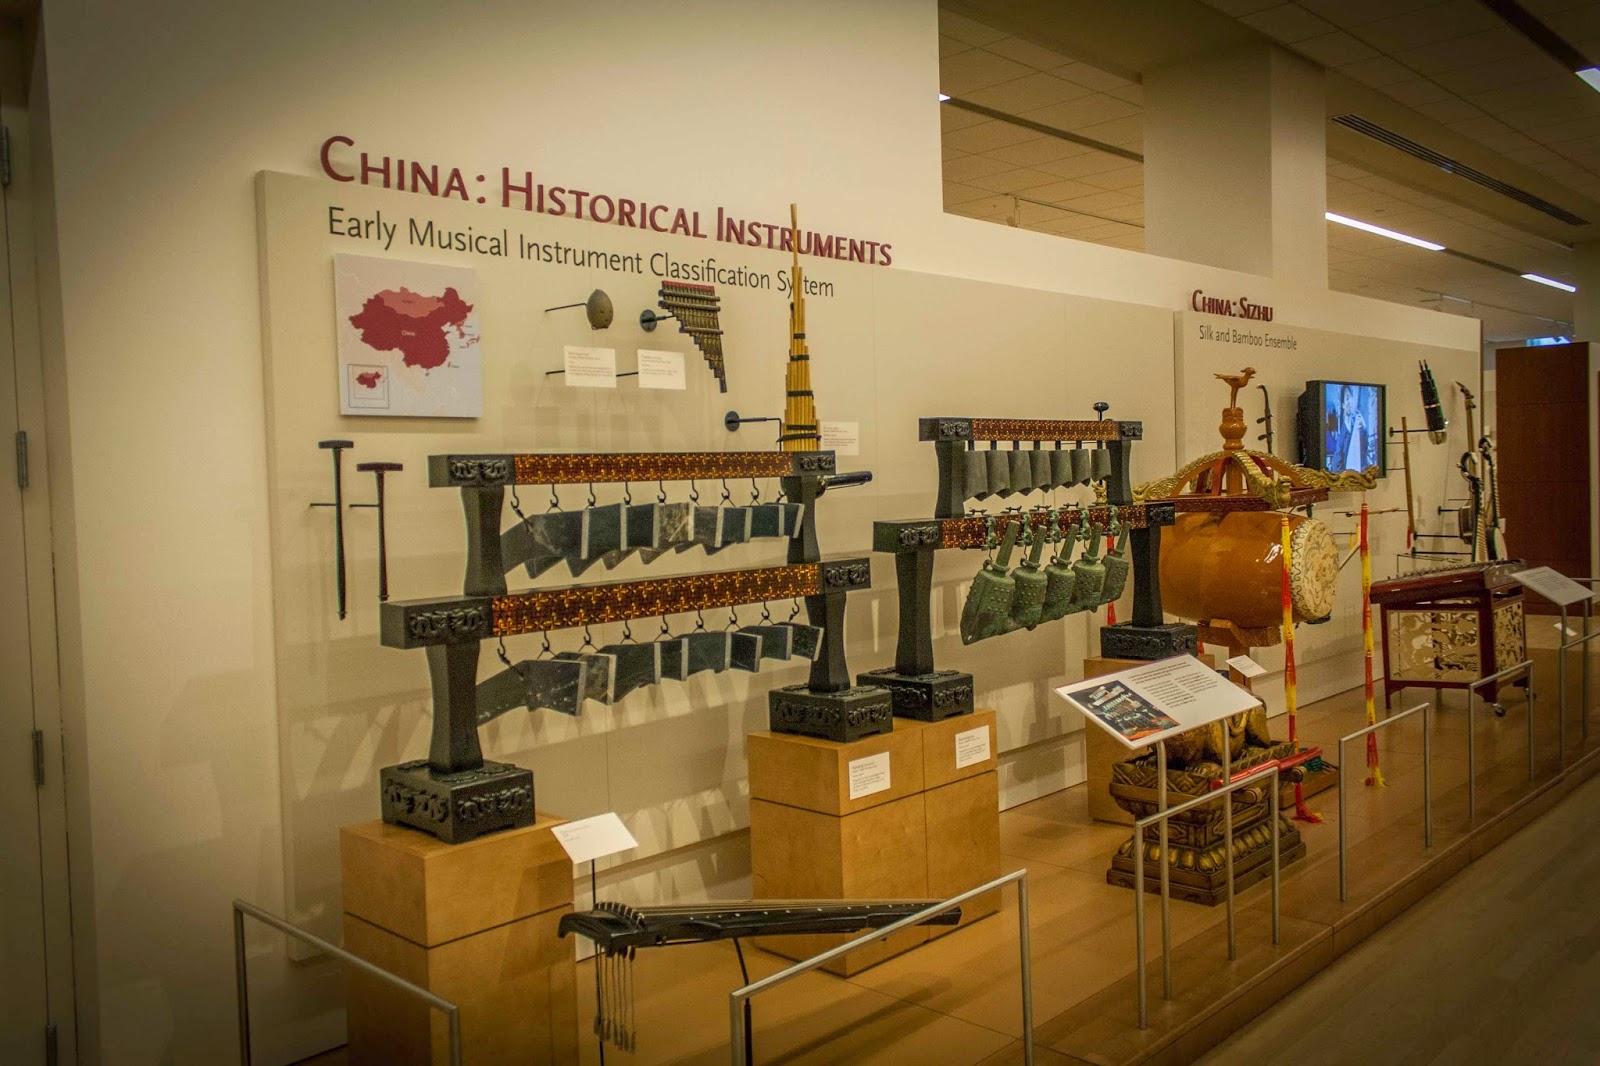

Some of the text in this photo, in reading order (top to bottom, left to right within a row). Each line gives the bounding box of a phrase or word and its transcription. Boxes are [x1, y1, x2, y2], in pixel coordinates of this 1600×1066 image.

[501, 166, 708, 240] HISTORICAL
[716, 206, 893, 267] INSTRUMENTS
[328, 206, 834, 300] Early Musical Instrument Classification Sytem
[1199, 324, 1298, 351] Silk and Bamboo Ensemble
[1238, 296, 1274, 322] SIZHU
